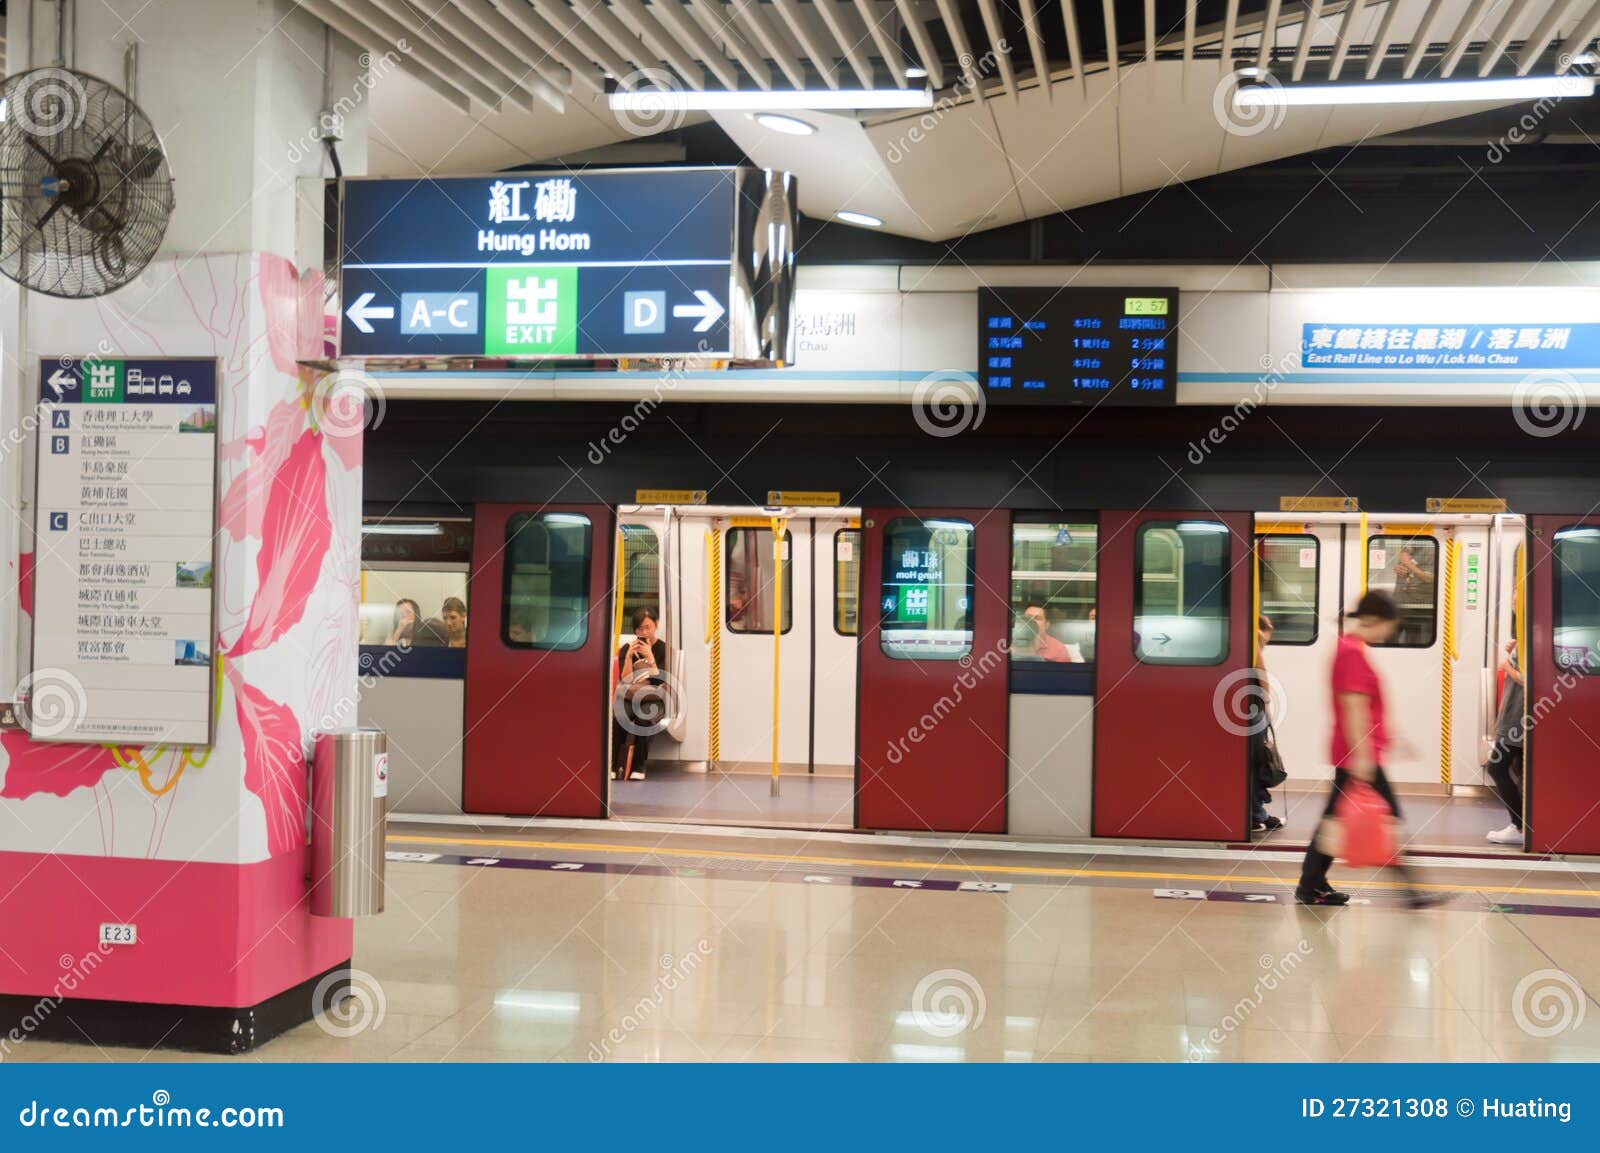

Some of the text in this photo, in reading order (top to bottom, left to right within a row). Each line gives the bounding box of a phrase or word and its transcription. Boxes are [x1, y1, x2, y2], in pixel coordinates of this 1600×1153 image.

[489, 180, 576, 224] 紅磡
[478, 230, 590, 255] Hung Hom
[409, 298, 469, 329] A-C
[1129, 301, 1166, 312] 12 57
[633, 300, 658, 328] D
[506, 325, 557, 344] EXIT
[1487, 327, 1572, 350] 落馬洲
[799, 341, 828, 351] Chau
[1073, 338, 1079, 348] 1
[1132, 338, 1139, 348] 2
[1132, 358, 1139, 368] 5
[1307, 353, 1332, 364] East
[1334, 353, 1355, 364] Rail
[1357, 353, 1383, 364] Line
[1384, 353, 1397, 364] to
[1399, 353, 1414, 364] Lo
[1415, 353, 1435, 364] Wu
[1443, 353, 1465, 364] Lok
[1467, 353, 1485, 364] Ma
[1487, 353, 1518, 364] Chau
[1073, 378, 1079, 388] 1
[1131, 378, 1139, 389] 9
[90, 388, 115, 398] EXIT
[55, 413, 66, 427] A
[82, 410, 154, 423] 香港理工大學
[56, 437, 65, 452] B
[54, 514, 64, 529] C
[79, 512, 136, 526] C出口大堂
[79, 537, 127, 551] 巴士總站
[79, 563, 150, 577] 都會海逸酒店
[78, 589, 137, 602] 城際直通車
[78, 615, 162, 629] 城際直通車大堂
[104, 927, 131, 941] E23
